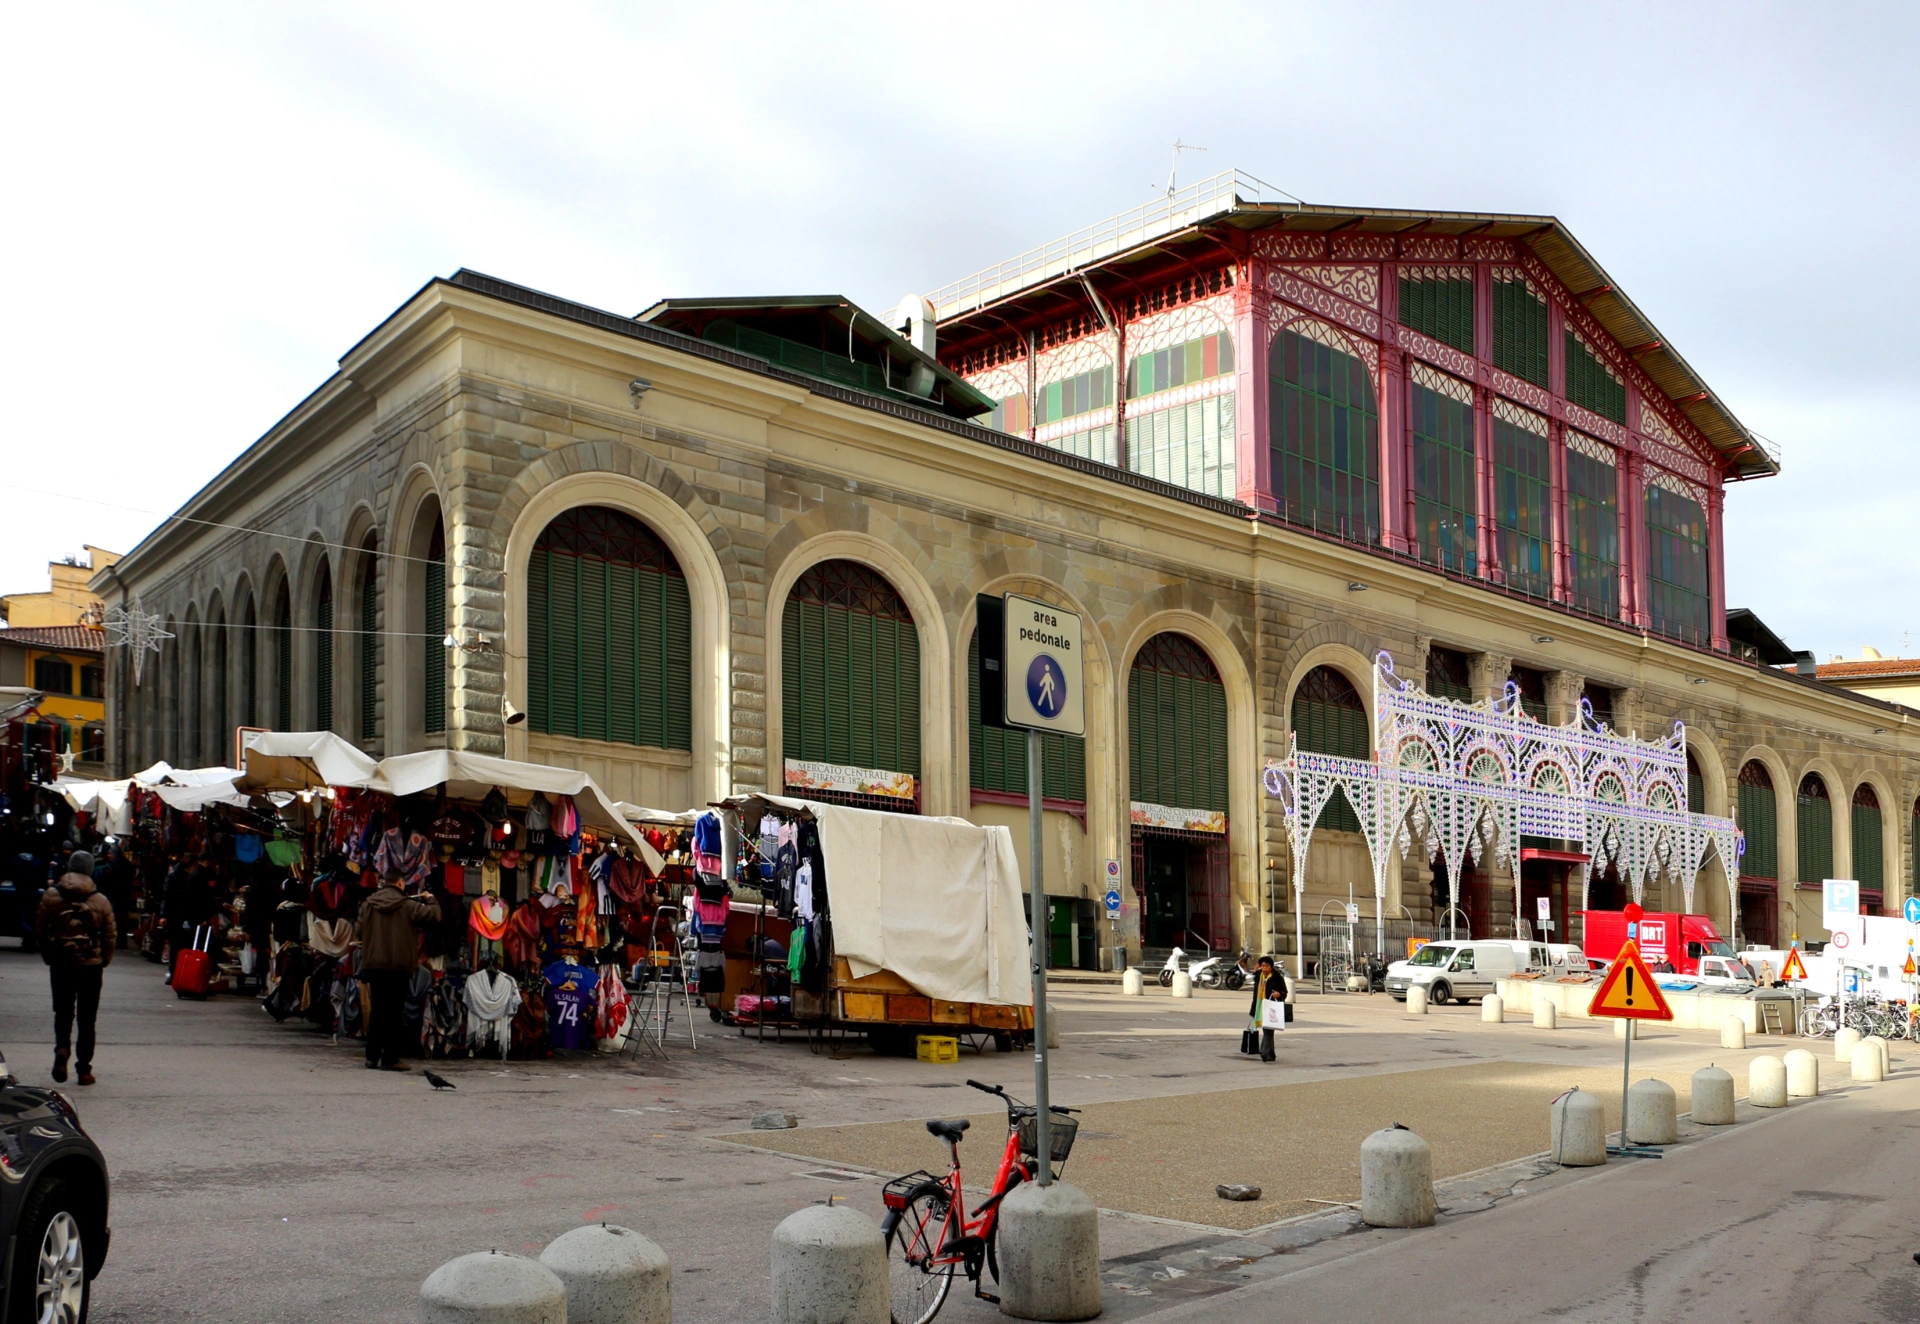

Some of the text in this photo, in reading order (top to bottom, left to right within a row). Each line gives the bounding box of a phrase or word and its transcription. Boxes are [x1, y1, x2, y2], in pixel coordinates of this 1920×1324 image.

[1033, 611, 1057, 627] area
[1020, 627, 1070, 650] pedonale
[798, 763, 889, 780] MERCATO CENTRALE
[812, 773, 846, 784] FIRENZE
[1140, 804, 1206, 818] MERCATO CENTRALE
[1150, 812, 1176, 822] FIRENZE
[1833, 884, 1850, 906] P
[1642, 926, 1663, 941] BRT
[1844, 976, 1855, 991] P
[557, 1001, 578, 1027] 74
